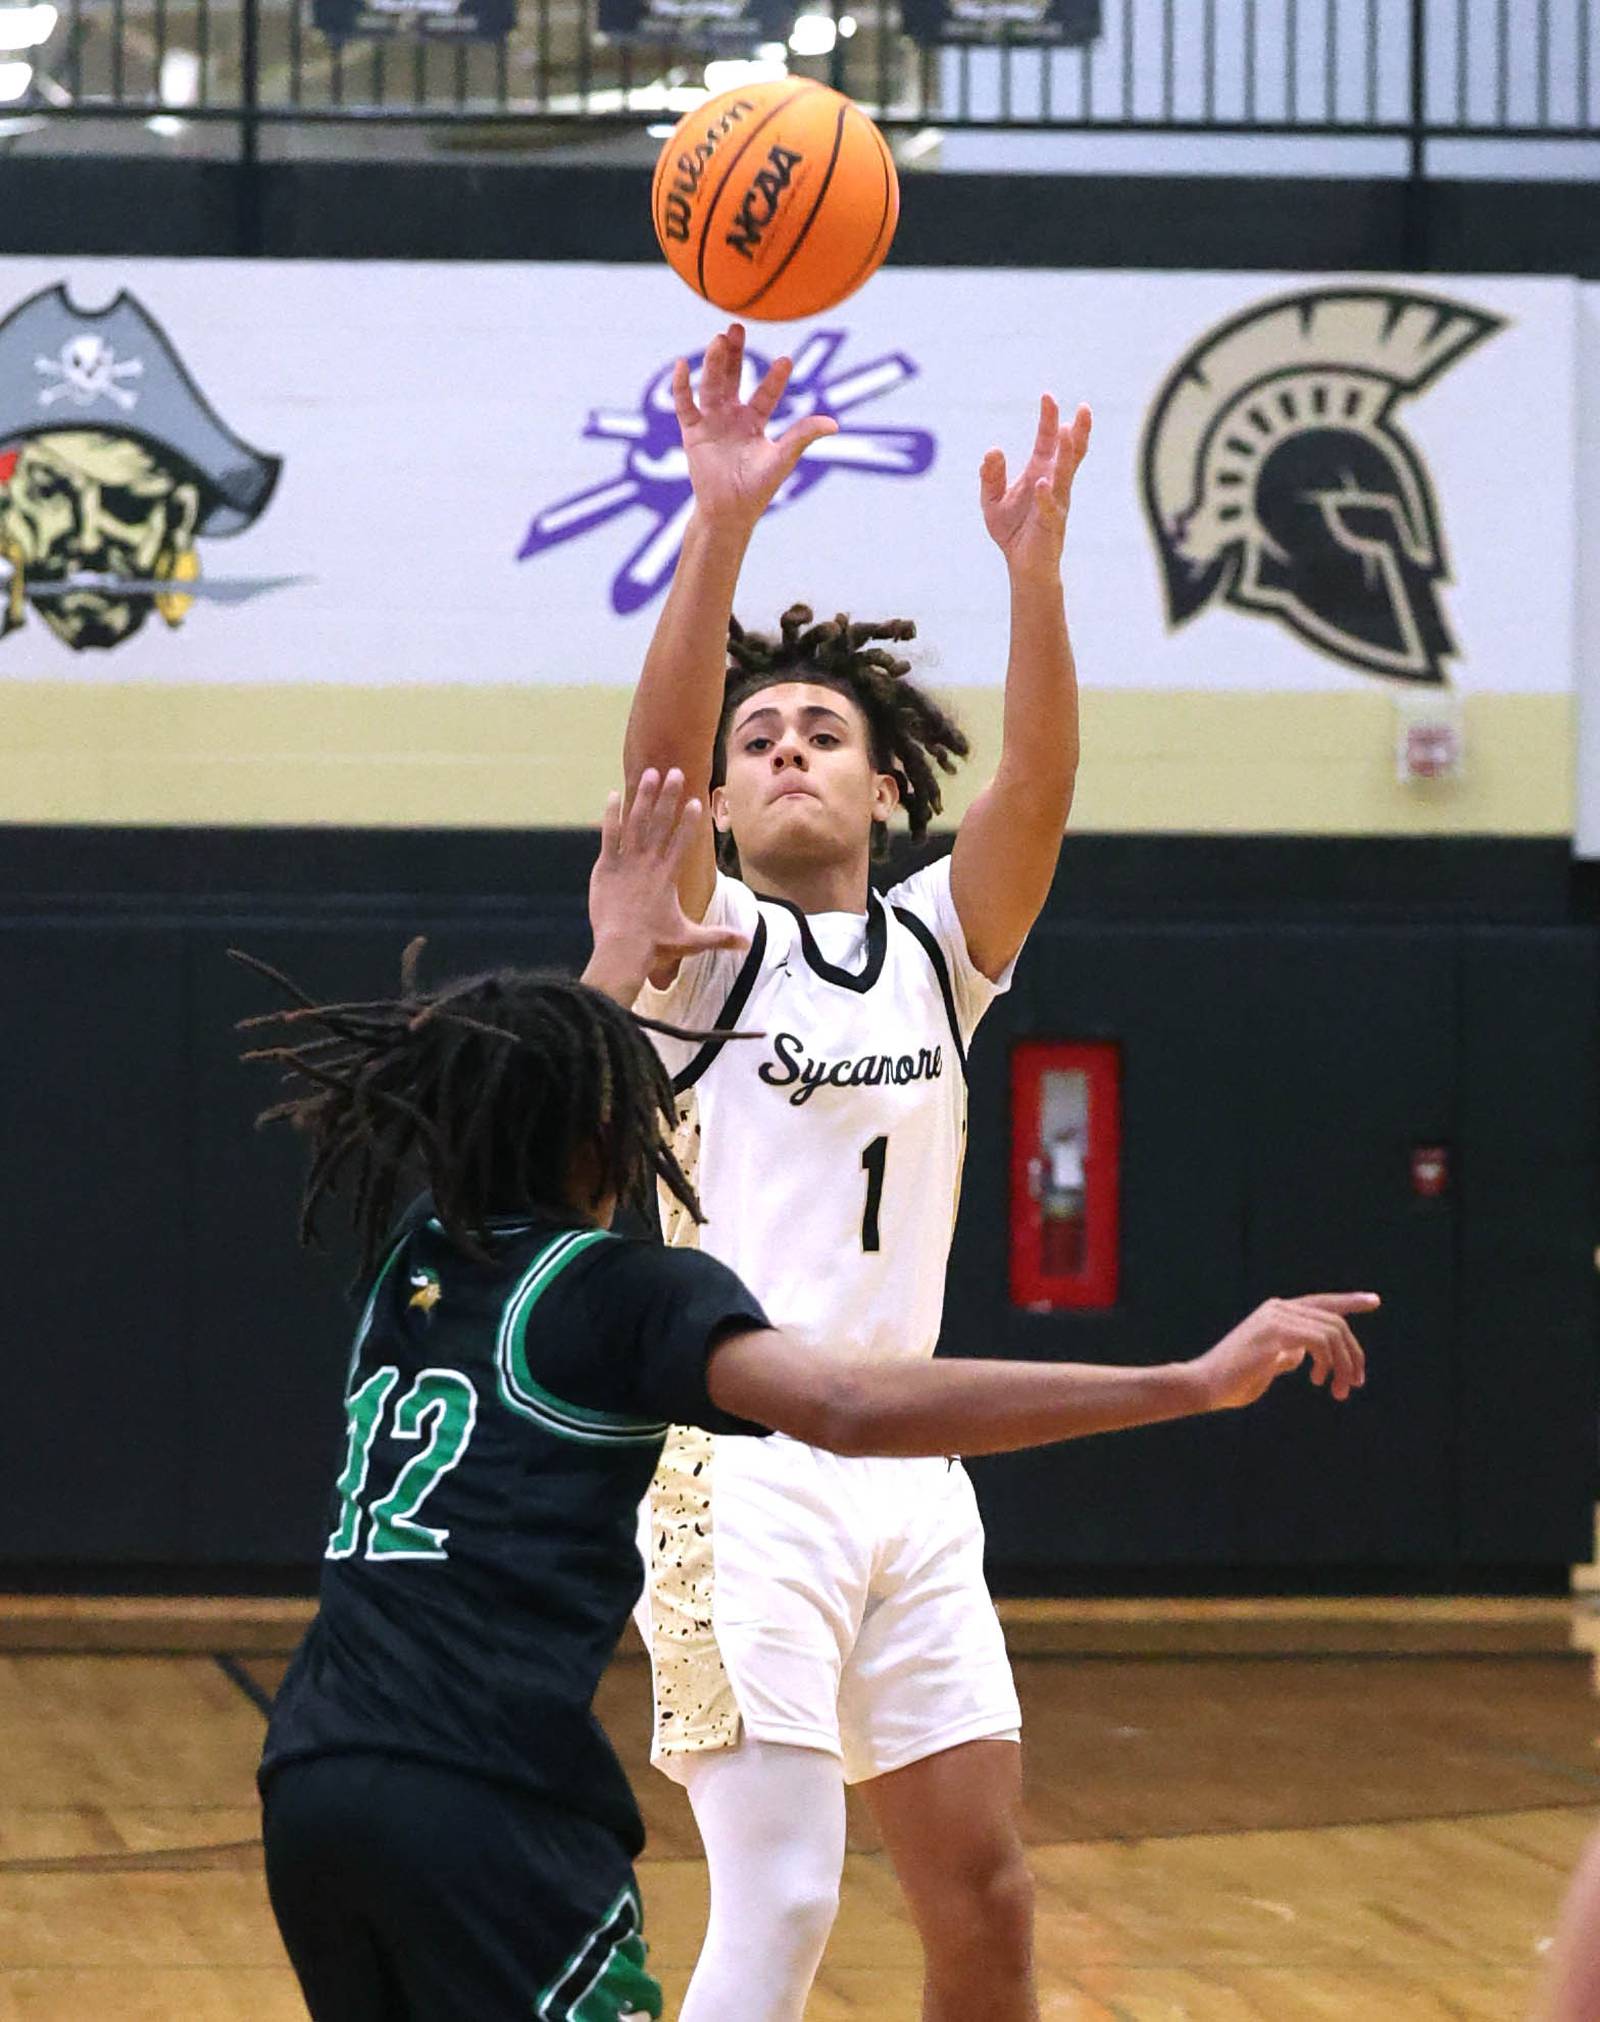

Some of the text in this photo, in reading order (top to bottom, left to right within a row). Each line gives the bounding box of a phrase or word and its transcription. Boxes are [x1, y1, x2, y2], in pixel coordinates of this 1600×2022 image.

[665, 100, 754, 243] Wilson
[726, 144, 802, 260] NCAA
[758, 1032, 943, 1106] Sycamore
[861, 1135, 889, 1253] 1
[324, 1366, 478, 1559] 12
